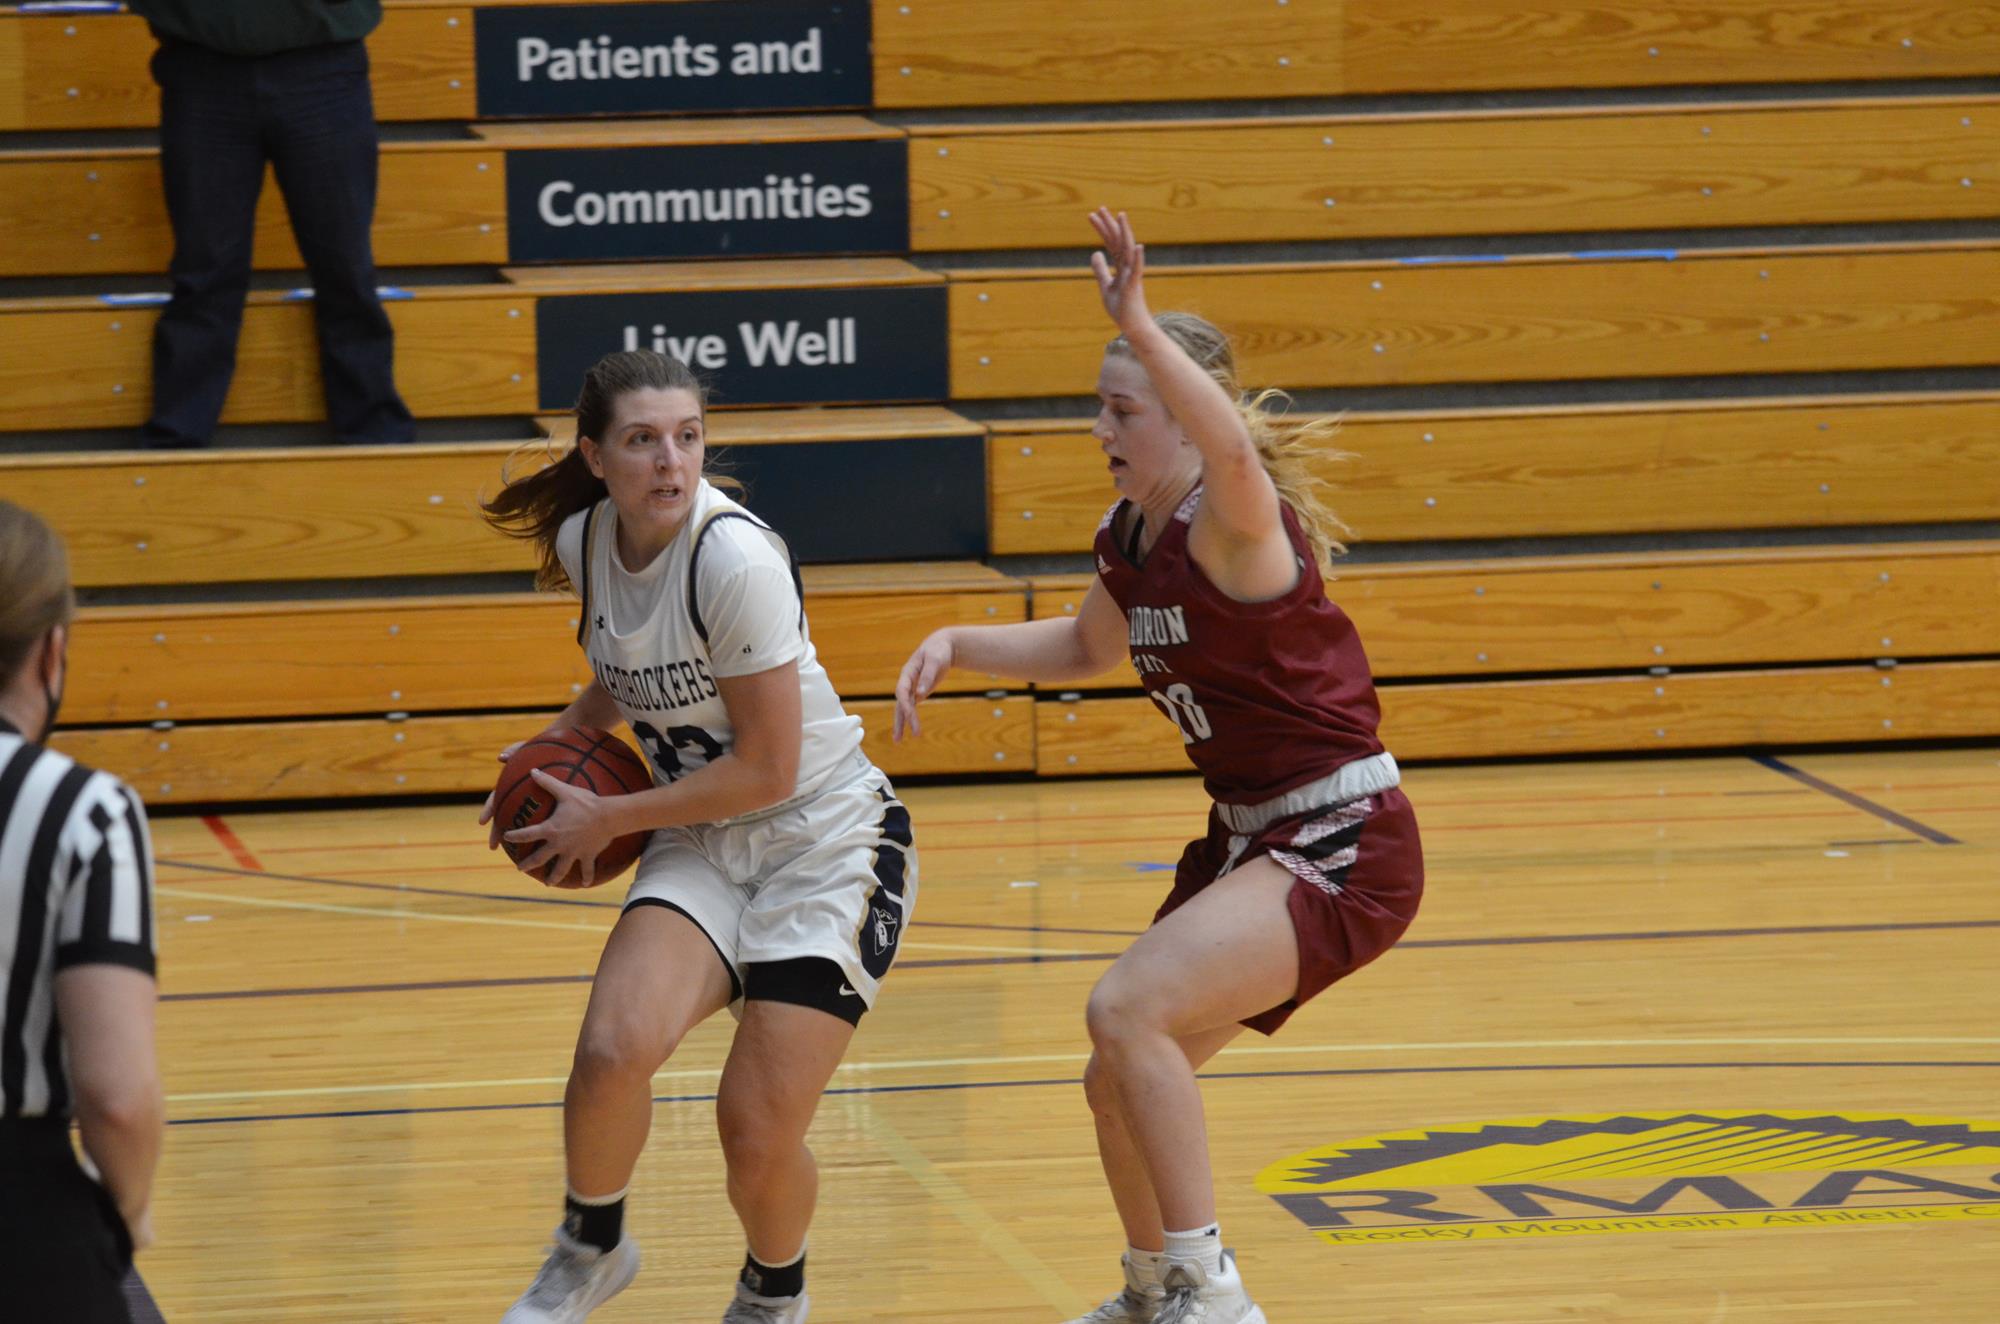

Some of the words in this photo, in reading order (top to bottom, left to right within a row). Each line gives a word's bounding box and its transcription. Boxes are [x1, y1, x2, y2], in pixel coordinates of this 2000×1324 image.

[516, 36, 720, 82] Patients
[731, 27, 822, 74] and
[538, 174, 872, 226] Communities
[624, 324, 727, 369] Live
[739, 317, 856, 366] Well
[1269, 1169, 2000, 1227] RMA
[1330, 1227, 1475, 1242] Rocky
[1496, 1216, 1739, 1235] Mountain
[1762, 1207, 1949, 1225] Athletic
